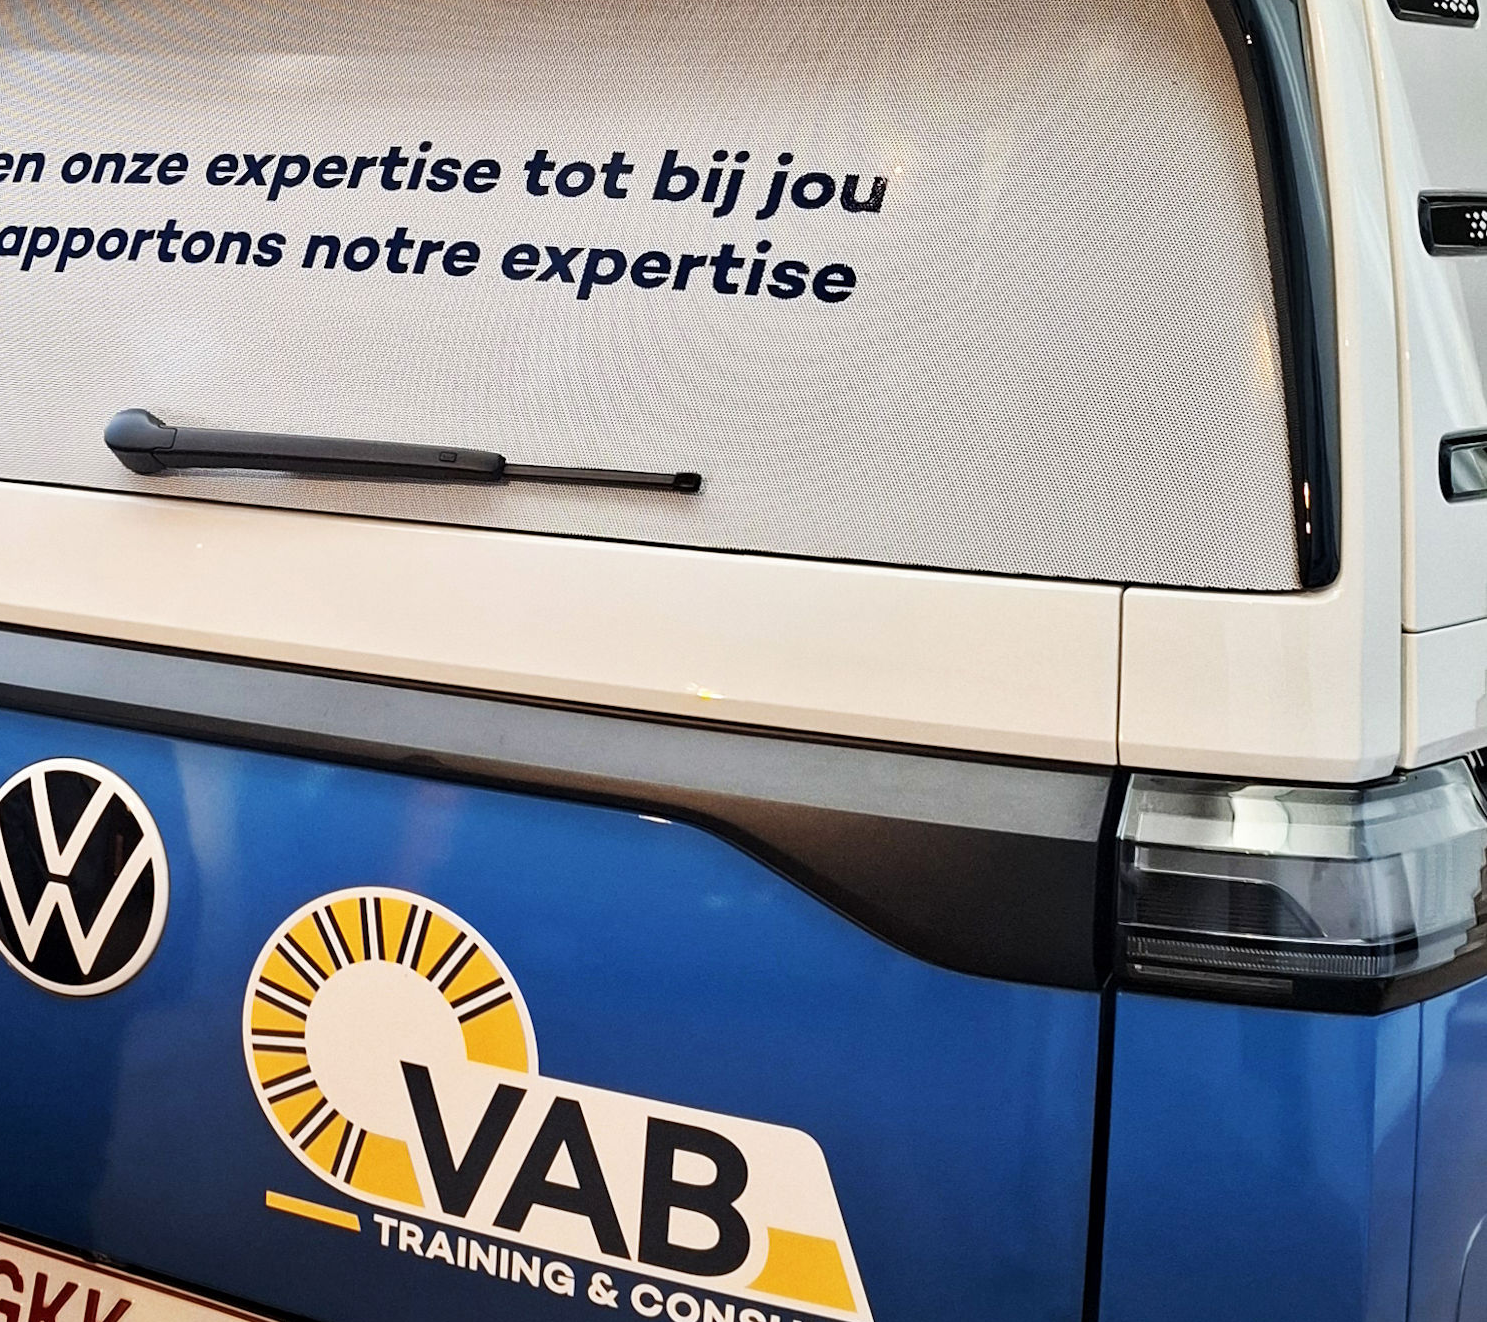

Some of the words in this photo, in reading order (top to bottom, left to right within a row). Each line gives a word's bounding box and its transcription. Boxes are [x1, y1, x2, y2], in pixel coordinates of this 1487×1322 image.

[61, 152, 189, 185] onze
[205, 141, 501, 202] expertise
[524, 150, 634, 199] tot
[653, 150, 750, 218] bij
[755, 152, 888, 220] jou
[302, 227, 481, 277] notre
[501, 239, 857, 303] expertise
[400, 1060, 749, 1277] VAB
[373, 1213, 576, 1297] TRAINING
[587, 1272, 619, 1308] &
